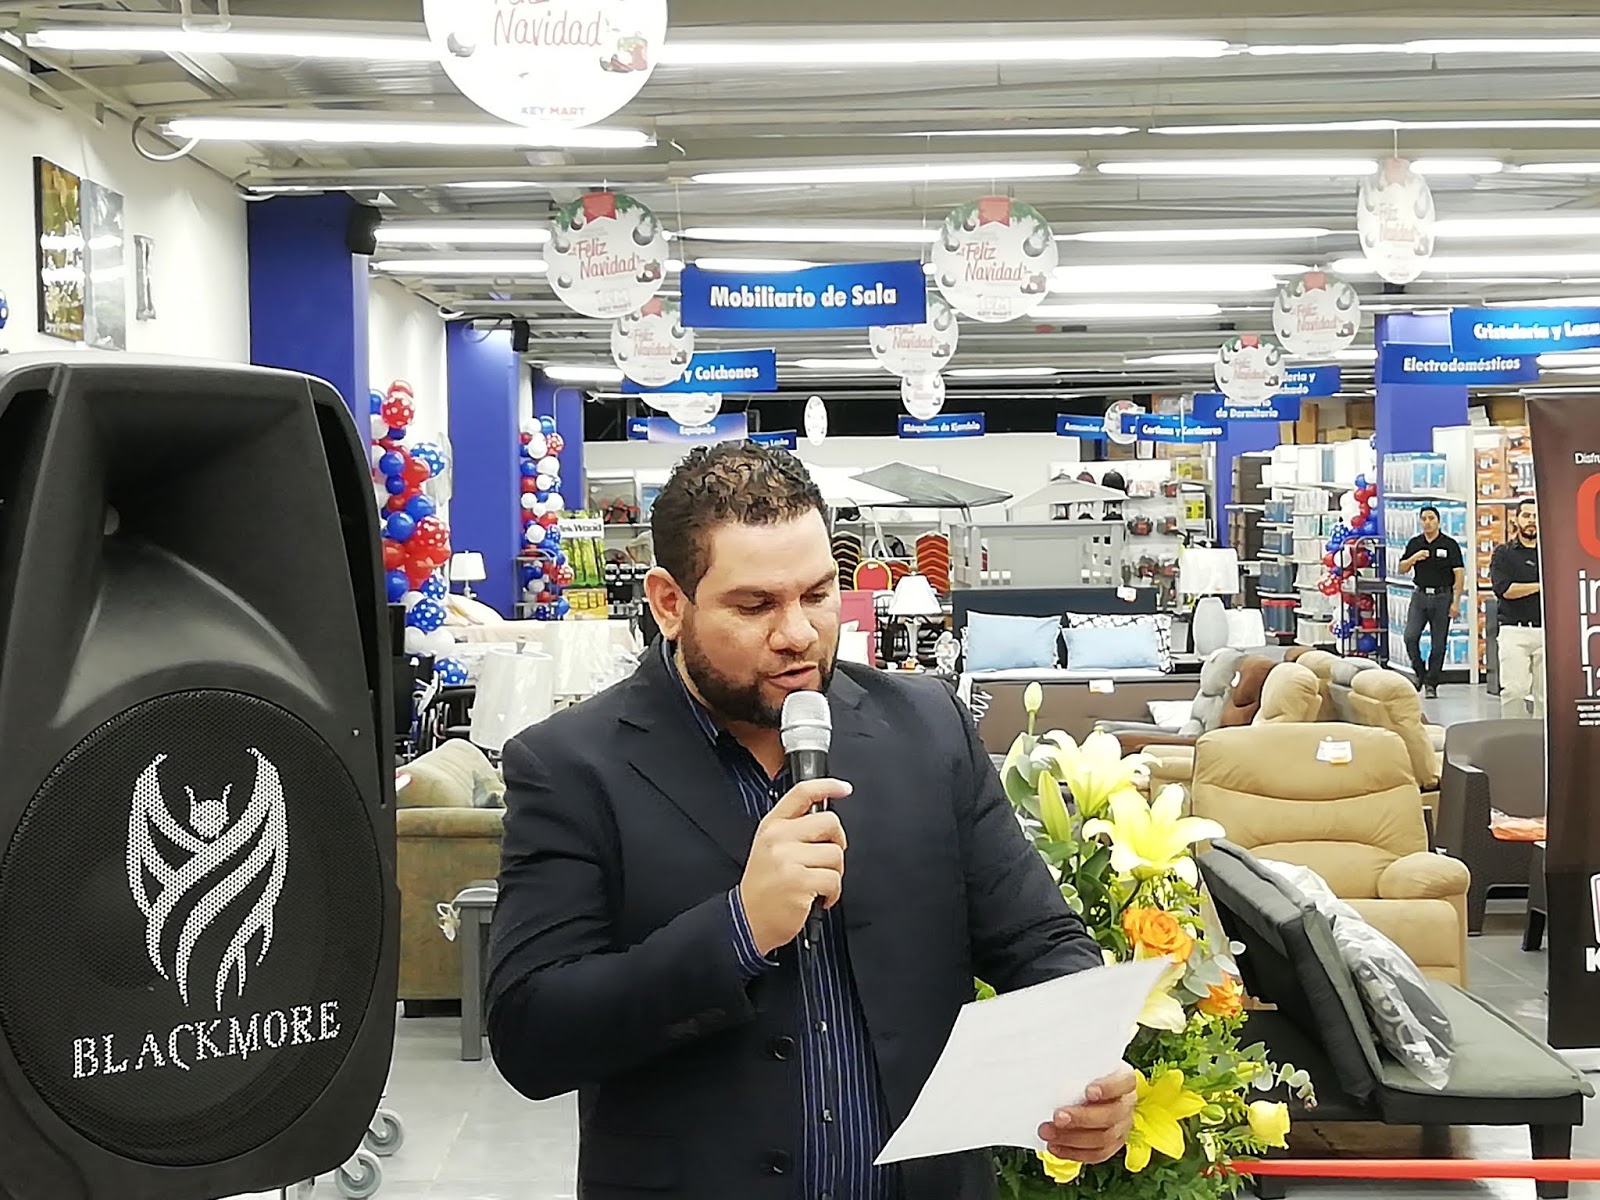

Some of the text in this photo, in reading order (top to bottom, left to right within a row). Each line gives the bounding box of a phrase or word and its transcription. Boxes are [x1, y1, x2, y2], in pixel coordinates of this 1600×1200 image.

[494, 10, 602, 46] Navidad
[549, 106, 586, 116] MART
[577, 238, 608, 259] Feliz
[966, 241, 996, 261] Feliz
[580, 253, 637, 280] Navidad
[965, 262, 1023, 281] Navidad
[710, 282, 897, 308] Mobiliario de Sala
[1551, 326, 1562, 341] y
[684, 369, 693, 383] y
[695, 364, 760, 381] Colchones
[1403, 357, 1521, 373] Electrodomésticos
[1309, 372, 1317, 383] y
[1229, 408, 1278, 418] Dormitorio
[72, 1000, 341, 1078] BLACKMORE
